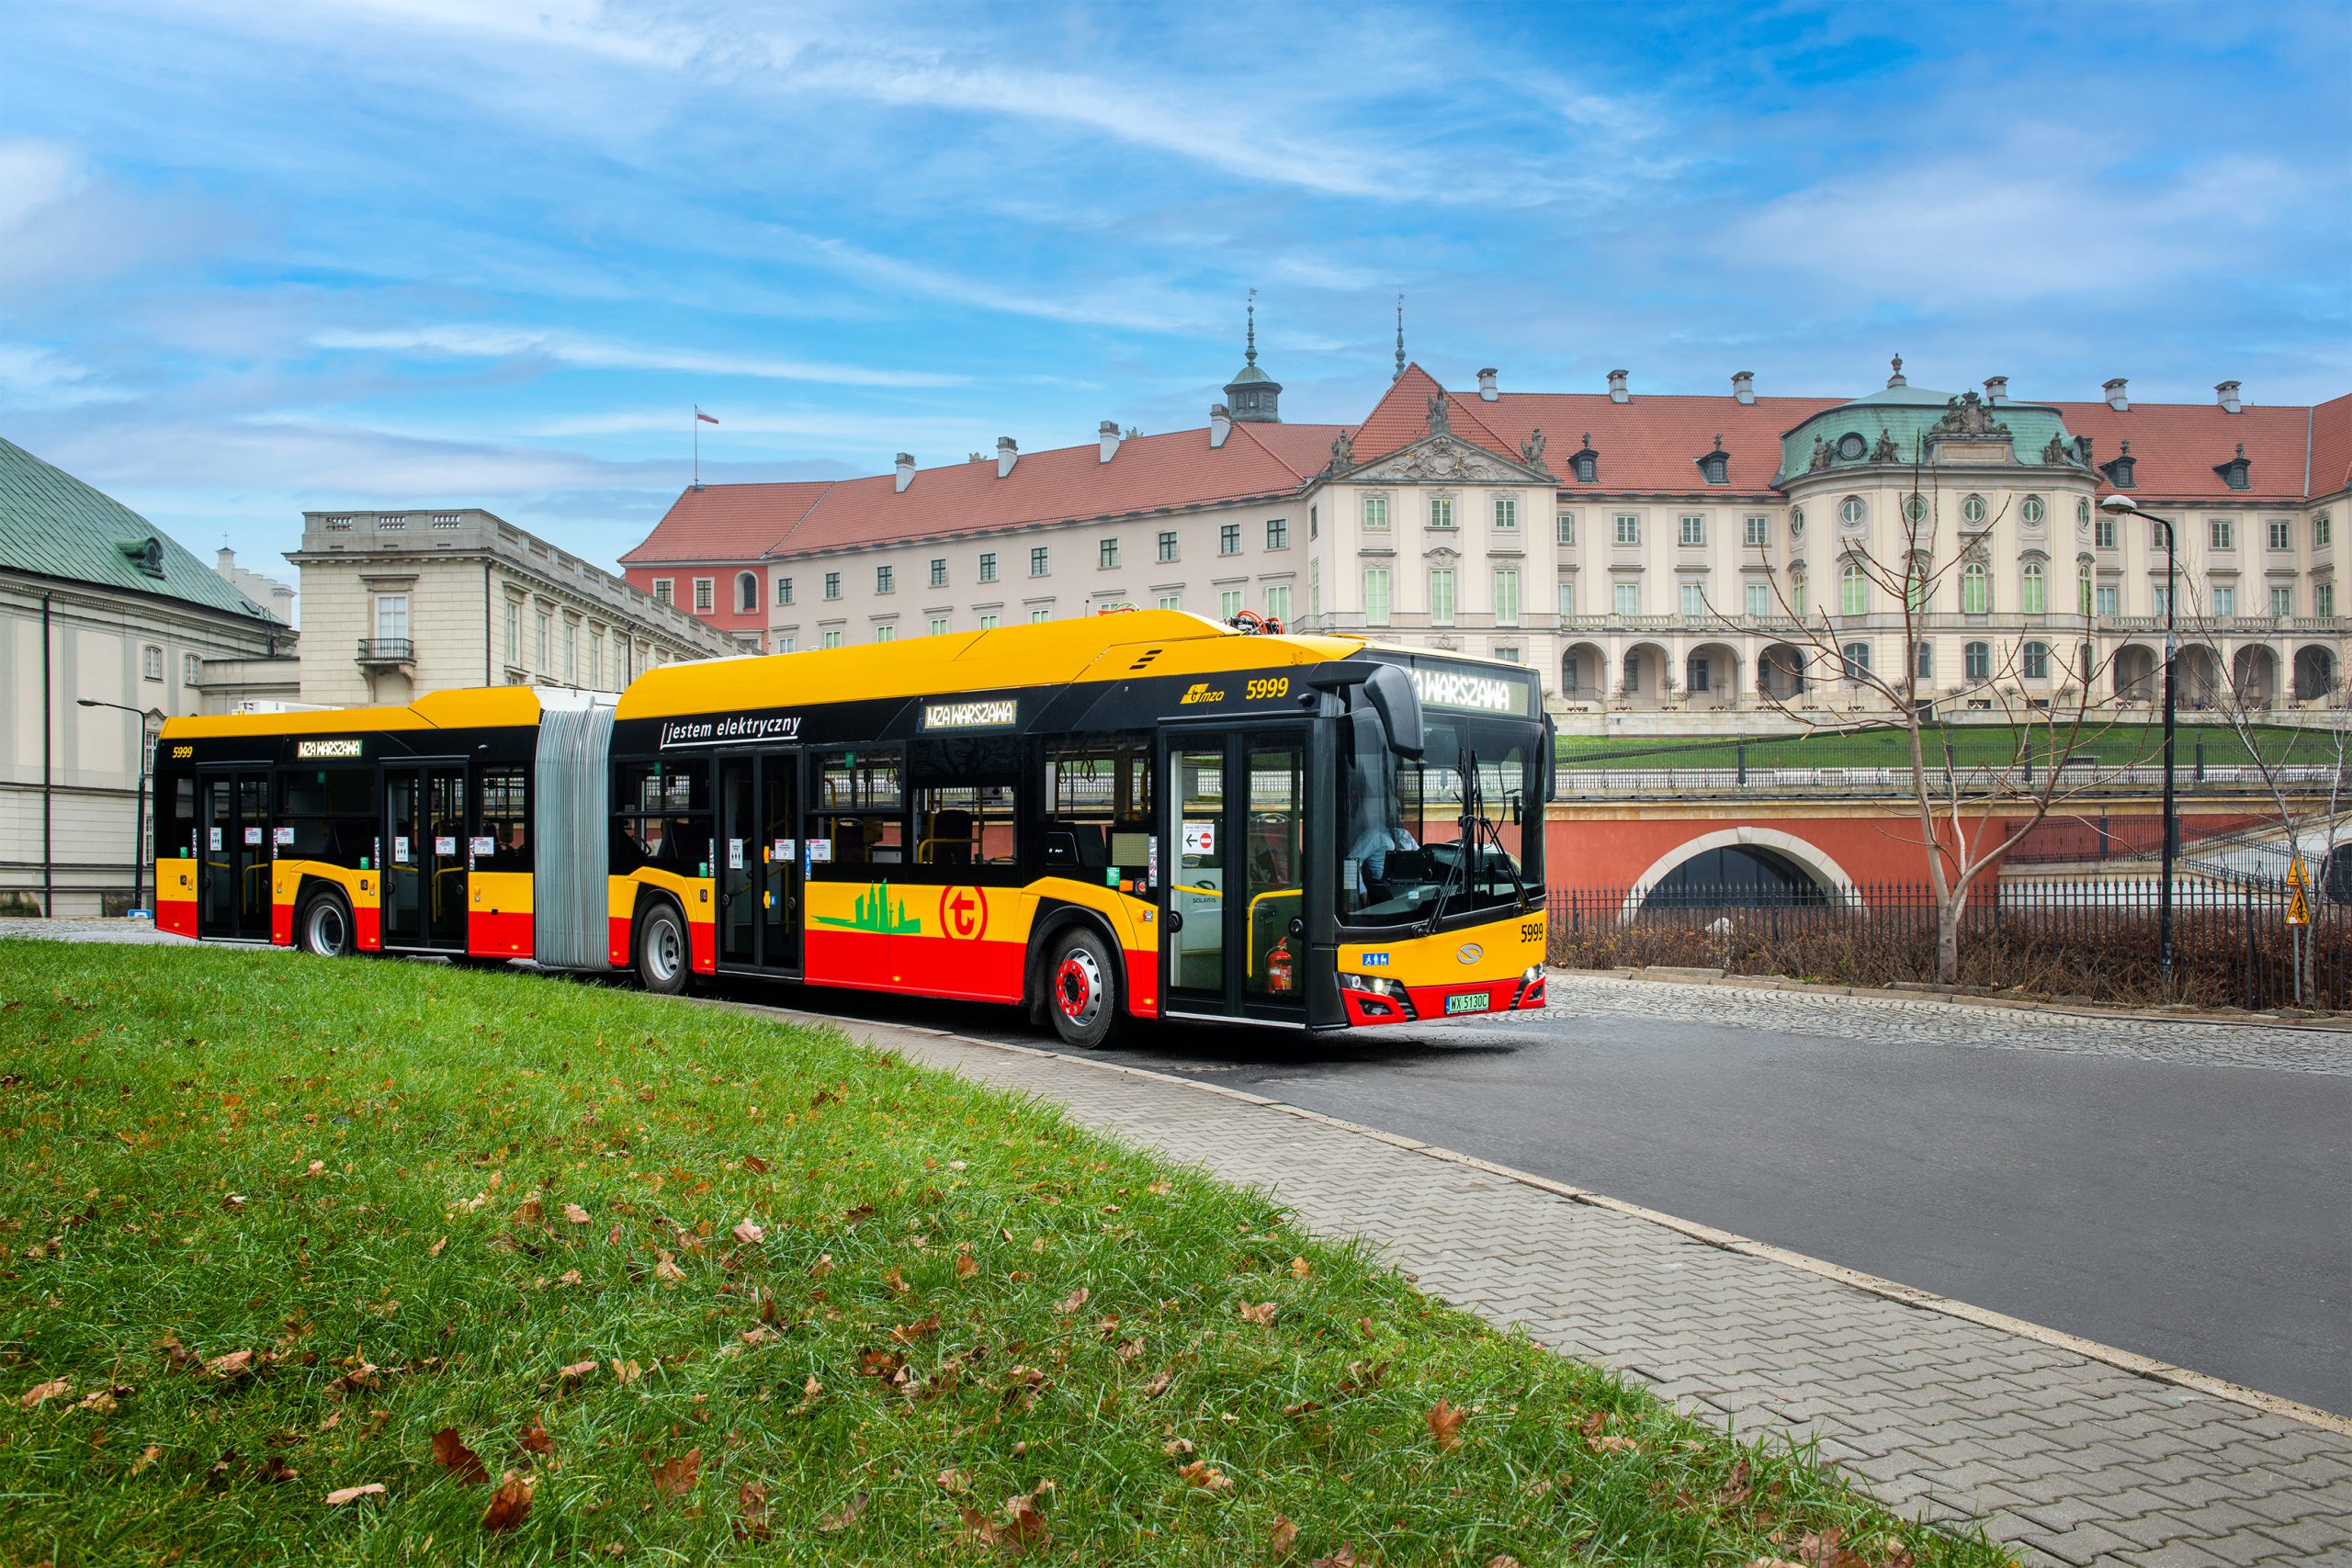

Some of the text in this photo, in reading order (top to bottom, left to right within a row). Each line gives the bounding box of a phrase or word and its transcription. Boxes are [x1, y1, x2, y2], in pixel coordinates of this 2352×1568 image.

[1245, 677, 1289, 700] 5999
[1425, 671, 1510, 710] WARSZAWA
[927, 702, 1013, 726] MZA WARSZAWA
[666, 716, 801, 743] jestem elektryczny
[172, 746, 193, 759] 5999
[317, 740, 360, 755] WARSZAWA
[1521, 922, 1544, 943] 5999
[1451, 994, 1487, 1010] WX 5130C
